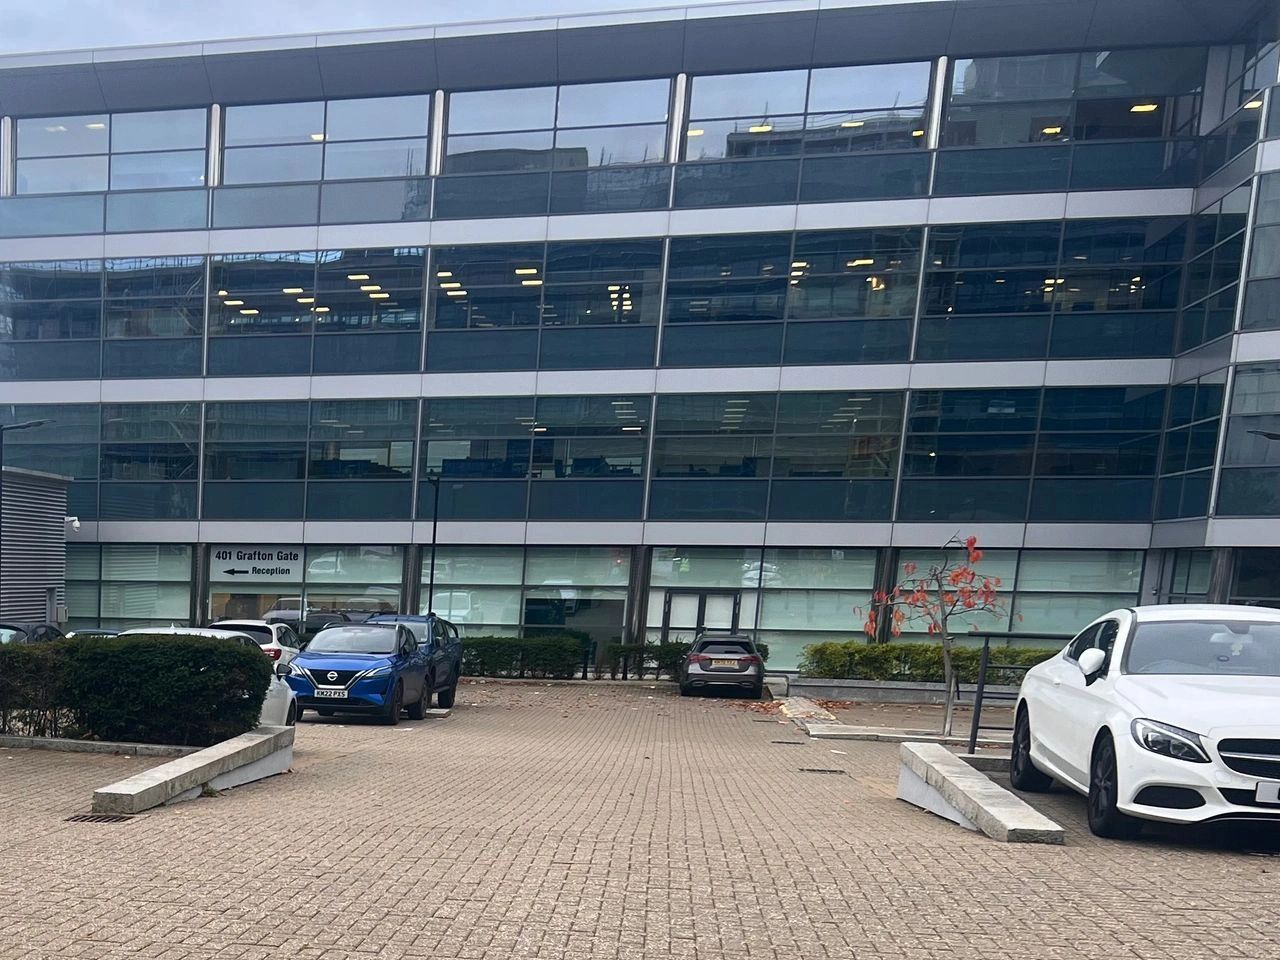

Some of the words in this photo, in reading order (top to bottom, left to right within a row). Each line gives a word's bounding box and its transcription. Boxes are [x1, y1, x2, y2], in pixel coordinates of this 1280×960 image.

[216, 551, 232, 561] 401
[236, 550, 273, 561] Grafton
[277, 551, 298, 561] Gate
[252, 566, 290, 576] Reception
